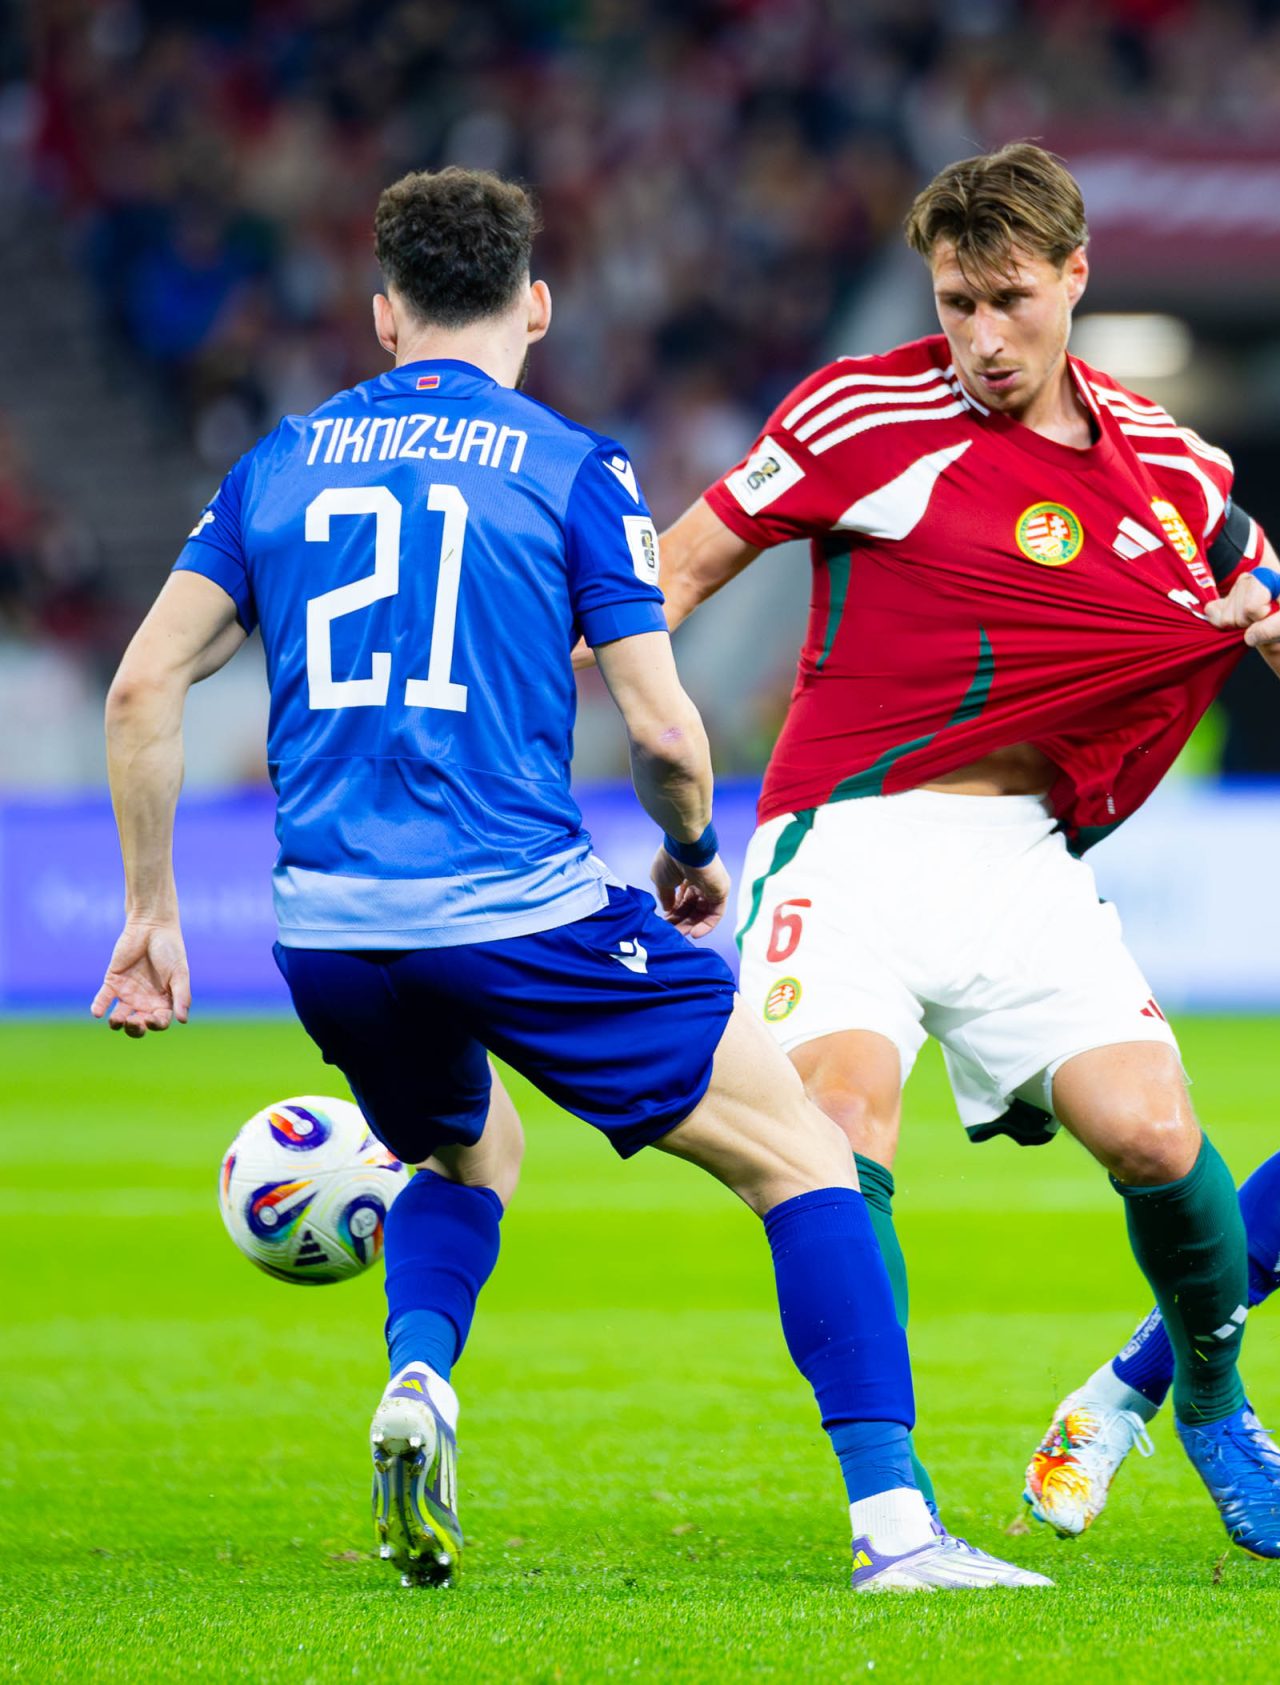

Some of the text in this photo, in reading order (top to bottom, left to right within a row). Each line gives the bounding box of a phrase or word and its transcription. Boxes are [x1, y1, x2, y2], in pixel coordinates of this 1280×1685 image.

[306, 413, 528, 474] TIKNIZYAN
[304, 483, 470, 713] 21
[766, 898, 812, 963] 6
